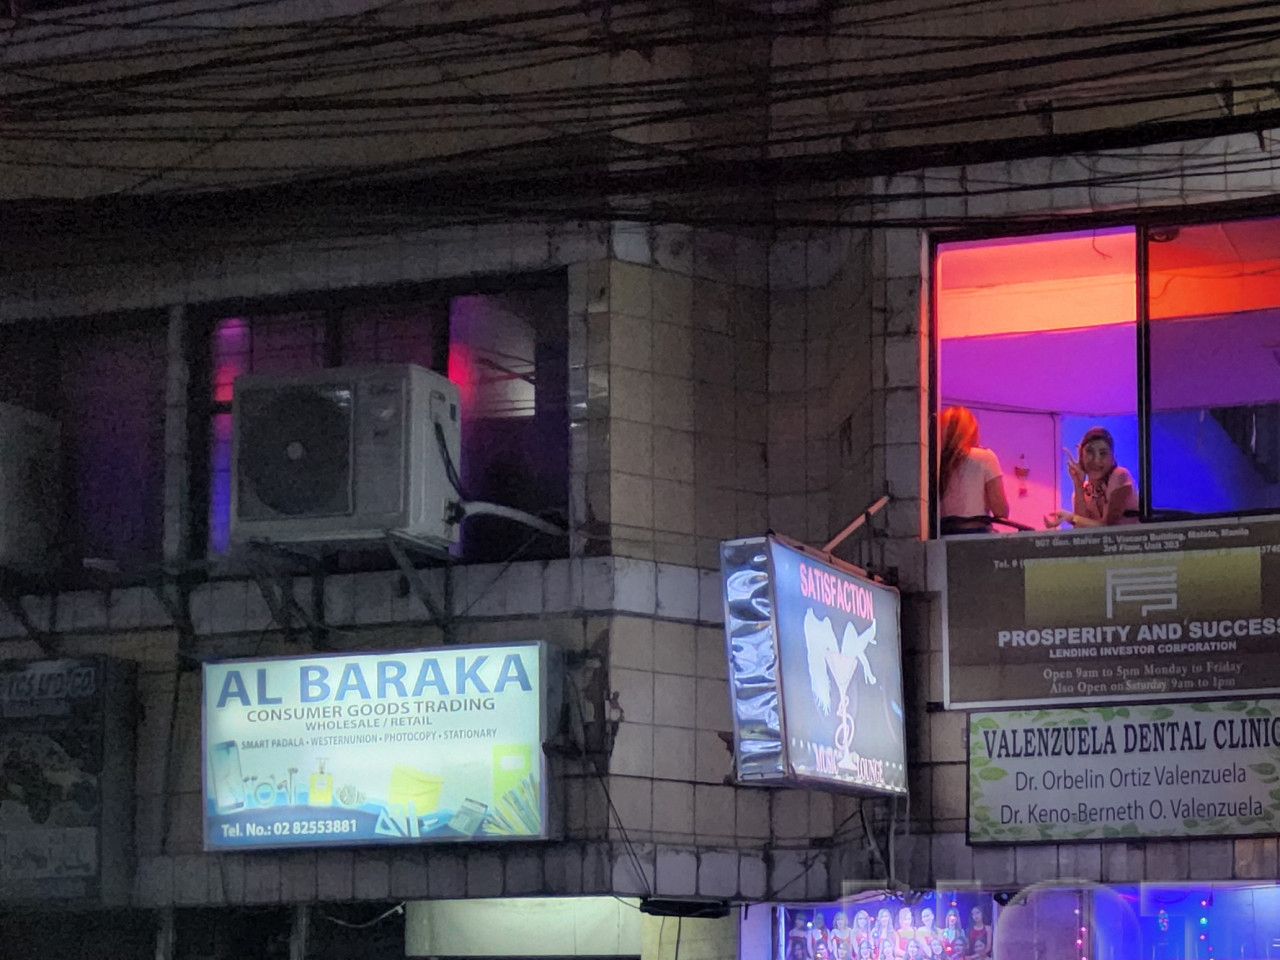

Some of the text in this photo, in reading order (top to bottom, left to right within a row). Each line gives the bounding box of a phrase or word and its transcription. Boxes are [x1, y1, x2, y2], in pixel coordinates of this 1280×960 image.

[799, 562, 874, 620] SATISFACTION
[998, 625, 1131, 647] PROSPERITY
[1137, 624, 1183, 641] AND
[1049, 640, 1237, 659] LENDING INVESTOR CORPORATION
[216, 653, 534, 709] AL BARAKA
[1043, 660, 1243, 682] Open 9am to 5pm Monday to Friday
[1050, 675, 1236, 696] Also Open on Saturday 9am to 1pm
[247, 697, 496, 723] CONSUMER GOODS TRADING
[305, 718, 381, 732] WHOLESALE
[390, 715, 433, 728] RETAIL
[241, 727, 498, 751] SMART PADALA WESTERNUNION PHOTOCOPY STATIONARY
[984, 724, 1118, 760] VALENZUELA
[1123, 719, 1208, 753] DENTAL
[854, 752, 885, 784] LOUNGE
[1015, 762, 1247, 791] Dr. Orbelin Ortiz Valenzuela
[1000, 796, 1264, 825] Dr. Keno-Berneth O. Valenzuela
[221, 819, 359, 837] Tel. No.: 02 82553881
